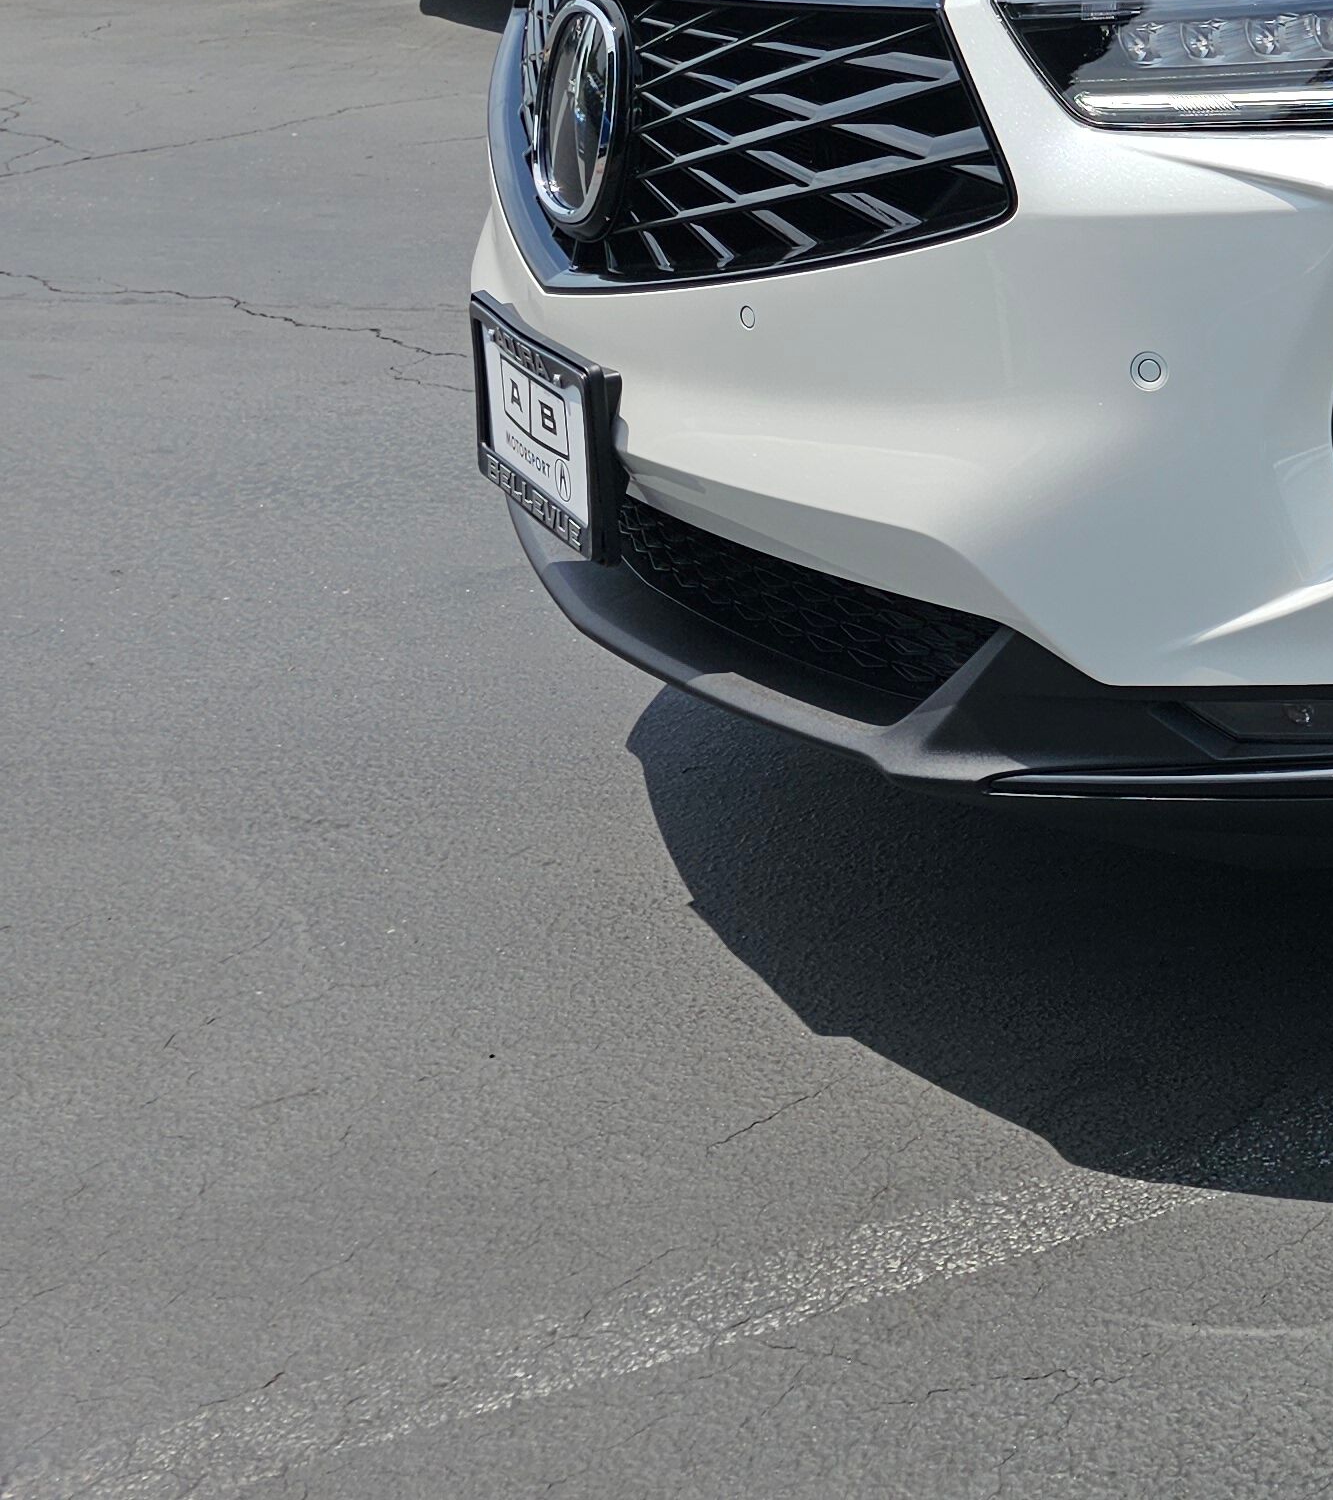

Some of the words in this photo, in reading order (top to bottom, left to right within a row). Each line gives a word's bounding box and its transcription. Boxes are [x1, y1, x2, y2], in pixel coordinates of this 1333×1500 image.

[493, 326, 551, 382] ACURA
[509, 377, 524, 414] A
[537, 398, 558, 437] B
[505, 429, 551, 479] MOTORSPORT
[486, 453, 582, 553] BELLEVUE
